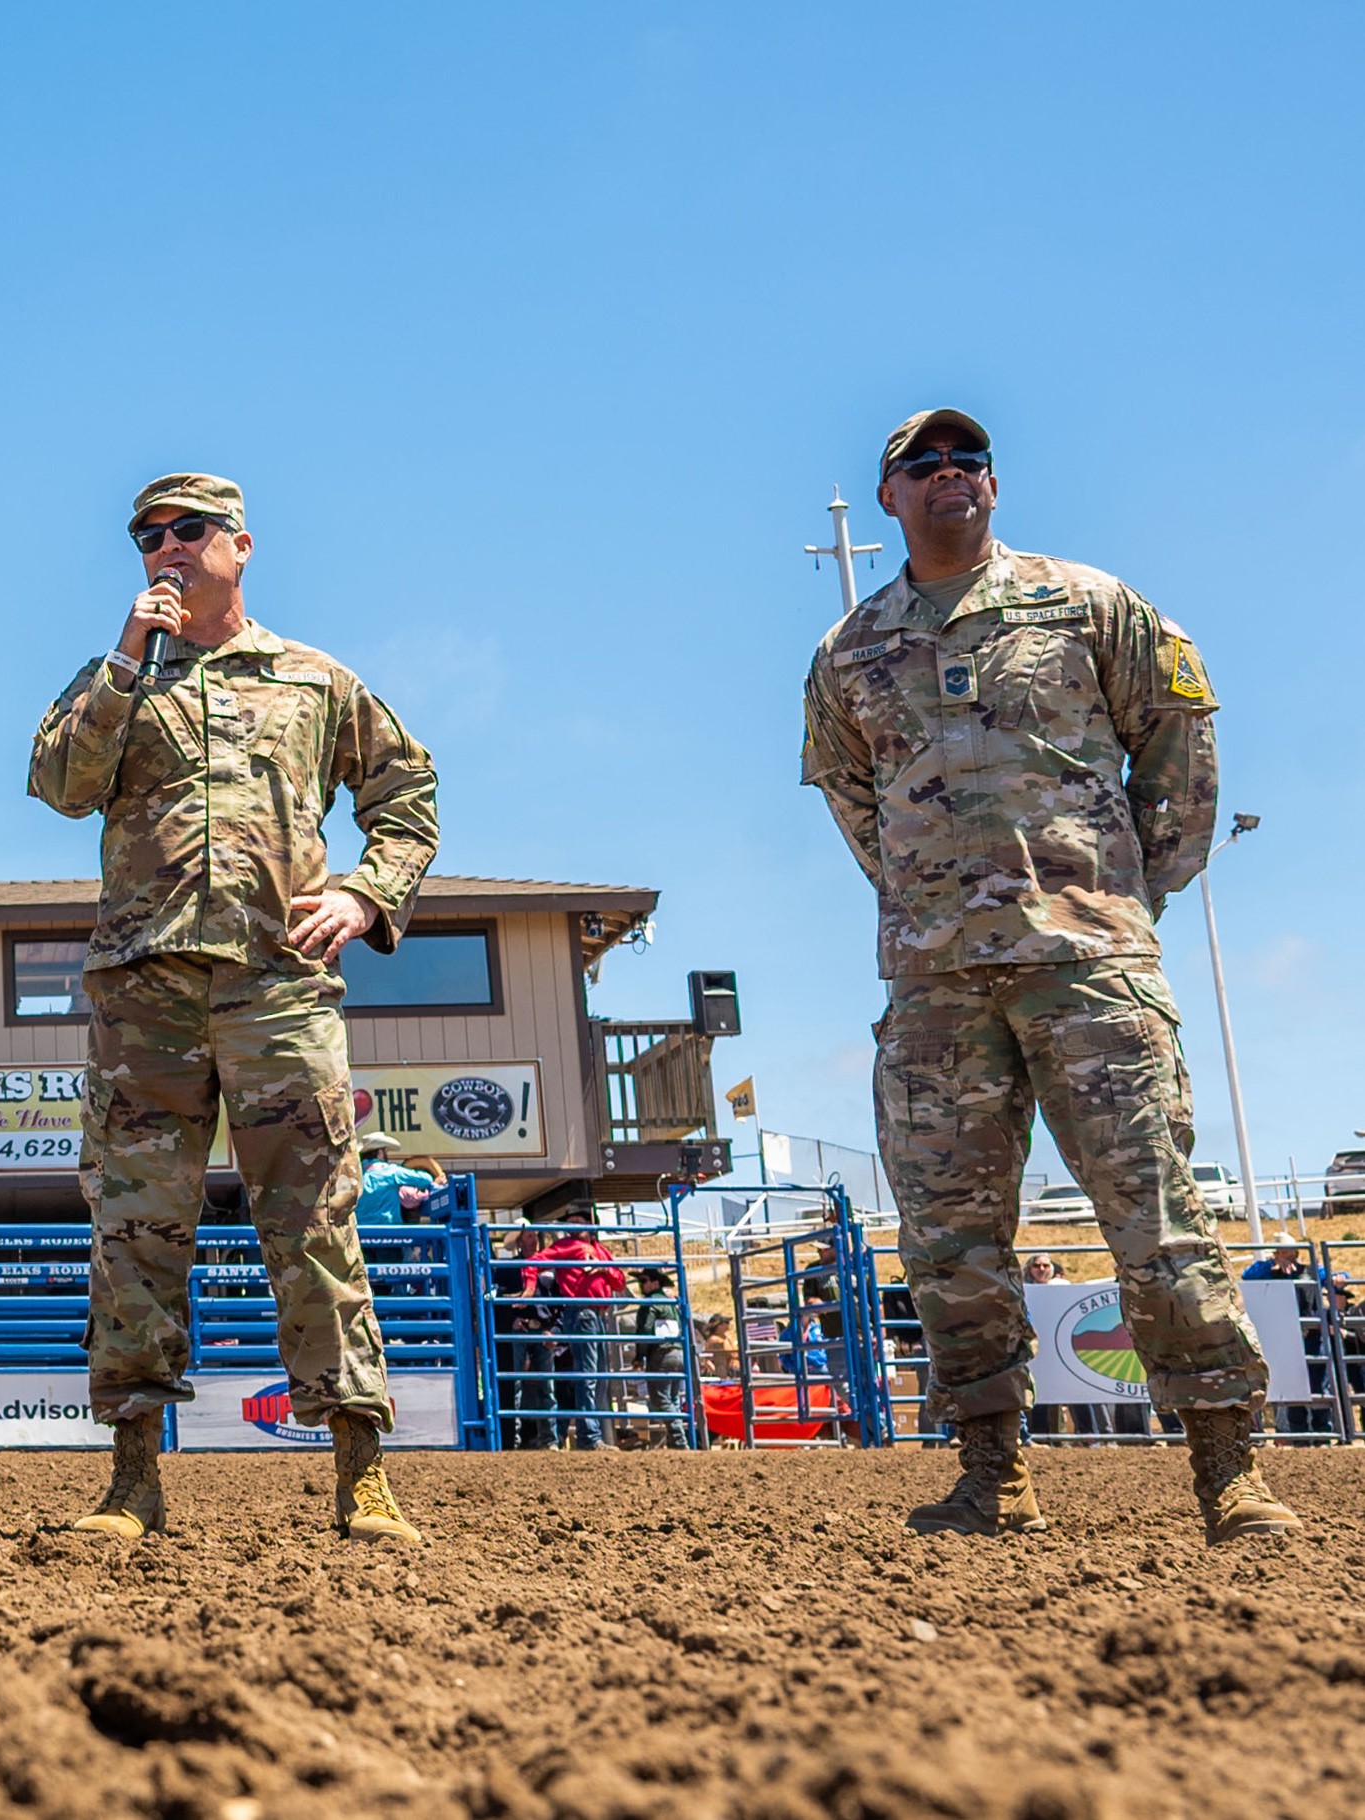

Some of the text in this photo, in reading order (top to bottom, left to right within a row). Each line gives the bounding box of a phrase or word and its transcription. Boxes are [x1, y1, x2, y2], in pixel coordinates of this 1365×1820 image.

[1027, 609, 1056, 621] SPACE
[1058, 603, 1088, 617] FORCE
[441, 1079, 506, 1100] COWBOY
[16, 1108, 72, 1129] Have
[375, 1088, 421, 1132] THE
[443, 1122, 505, 1139] CHANNEL
[1, 1266, 42, 1276] ELKS
[48, 1266, 91, 1276] RODE
[208, 1268, 262, 1277] SANTA
[377, 1266, 432, 1275] RODEO
[1079, 1291, 1118, 1314] SANT
[1115, 1381, 1149, 1396] SUP
[242, 1395, 293, 1424] DUP
[275, 1427, 316, 1440] BUSINESS
